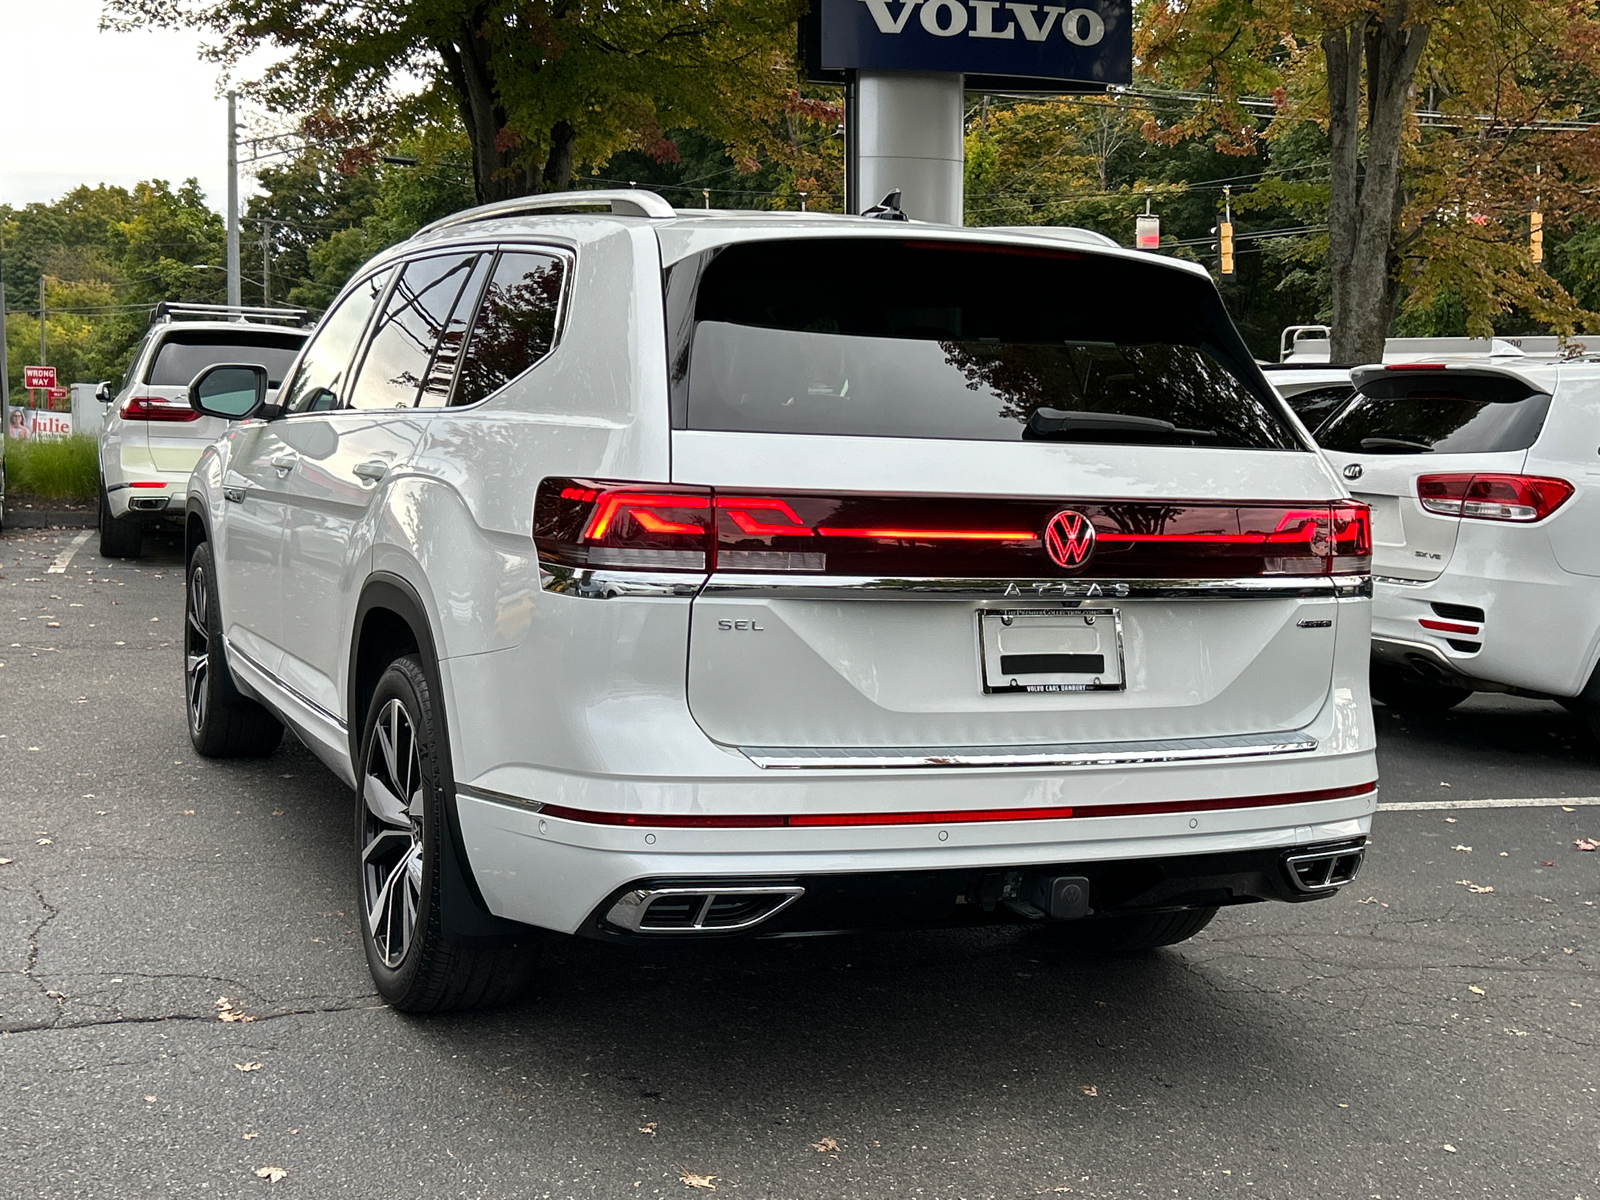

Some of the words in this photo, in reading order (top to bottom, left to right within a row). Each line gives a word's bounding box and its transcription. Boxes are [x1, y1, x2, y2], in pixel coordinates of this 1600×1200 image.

[856, 0, 1105, 47] VOLVO
[26, 369, 54, 377] WRONG
[32, 378, 49, 386] WAY
[32, 417, 69, 434] Julie
[1343, 465, 1361, 478] KIA
[1414, 550, 1428, 559] SX
[1003, 582, 1130, 597] ATLAS
[717, 618, 765, 632] SEL
[1026, 685, 1045, 693] VOLVO
[1060, 684, 1086, 692] DANBURY
